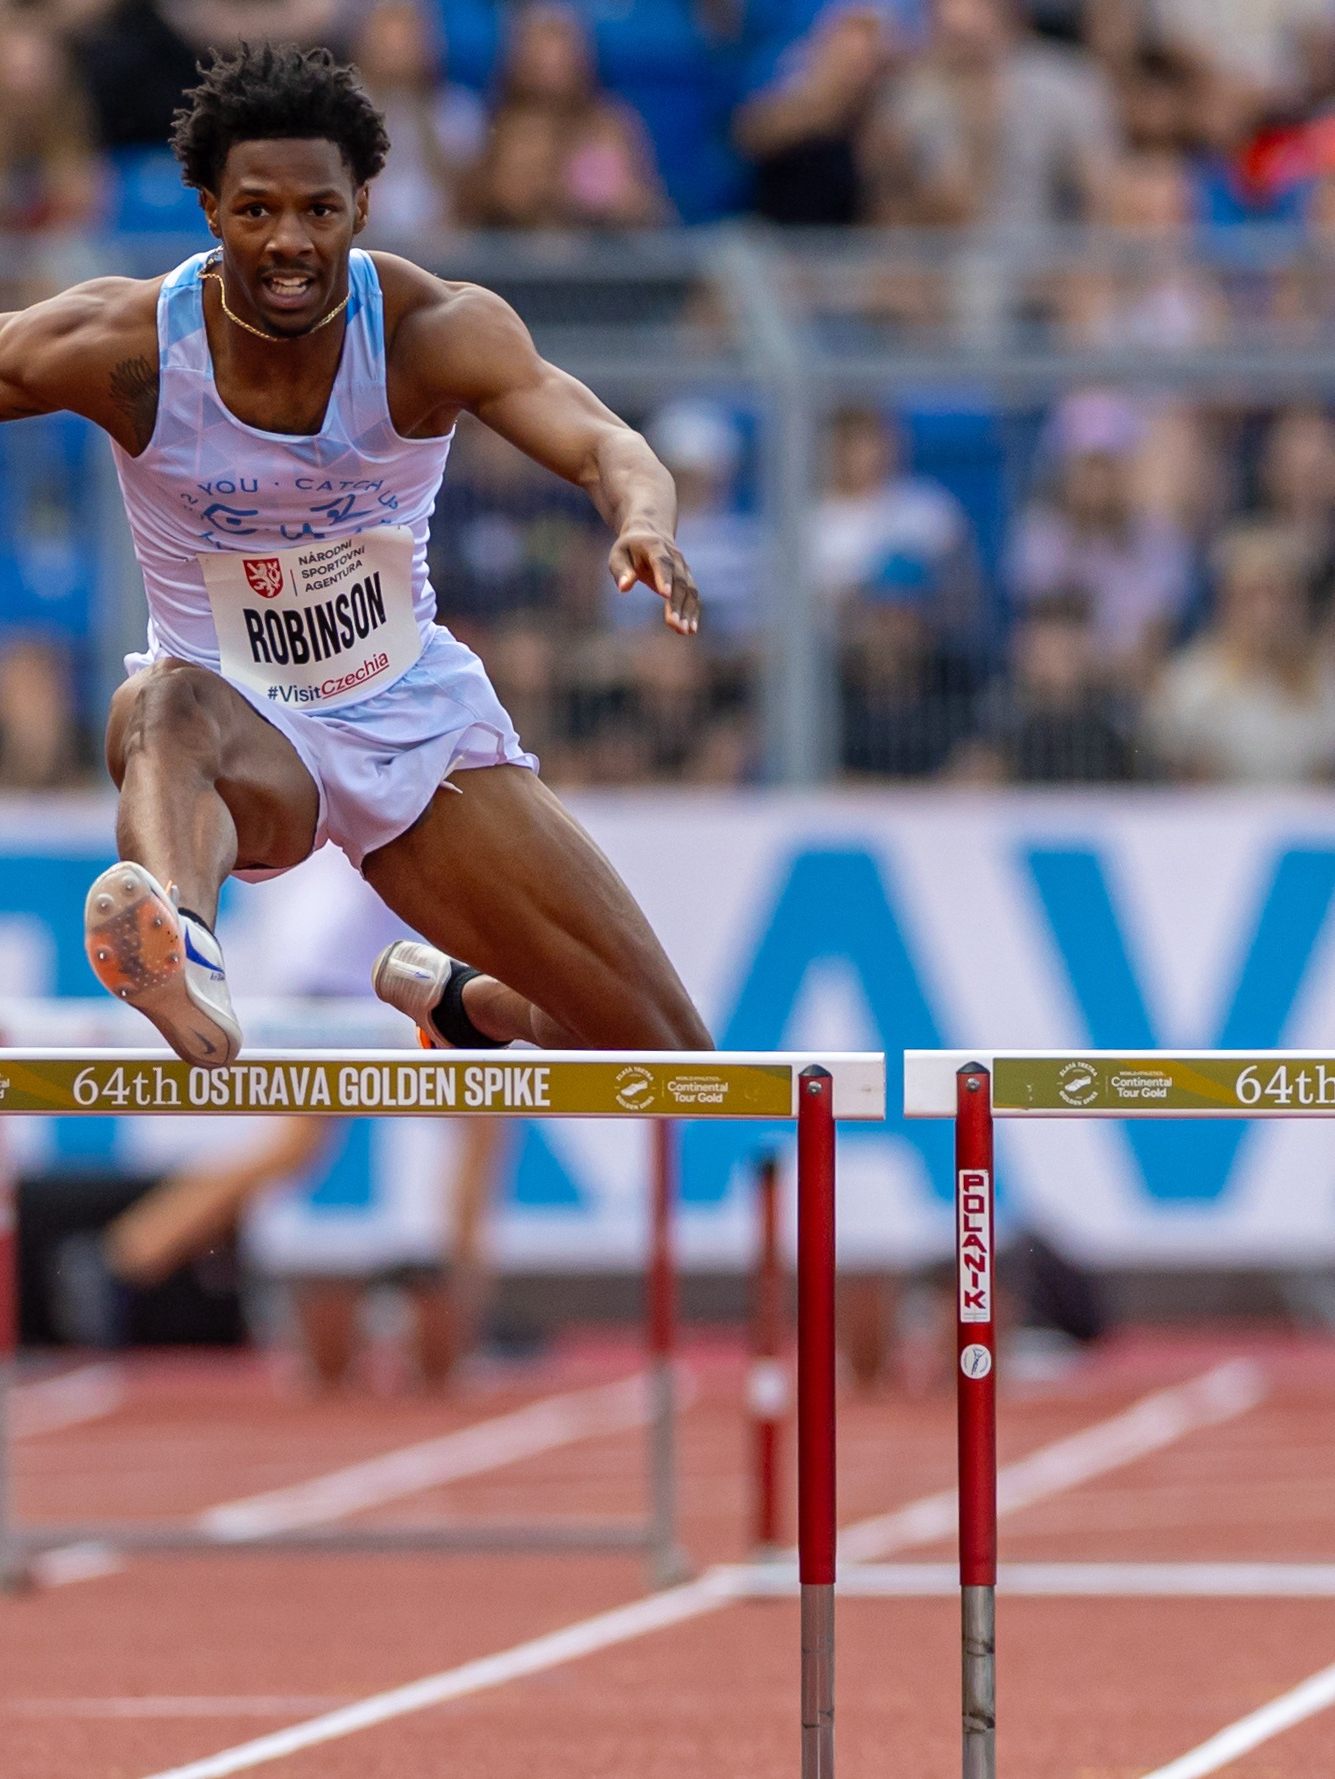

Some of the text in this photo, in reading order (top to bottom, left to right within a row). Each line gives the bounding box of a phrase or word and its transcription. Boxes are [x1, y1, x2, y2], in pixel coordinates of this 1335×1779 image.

[198, 478, 258, 497] YOU
[295, 478, 383, 492] CATCH
[299, 539, 352, 566] NÁRODNÍ
[301, 545, 365, 579] SPORTOVNÍ
[305, 560, 363, 593] AGENTURA
[243, 571, 387, 665] ROBINSON
[268, 652, 389, 702] #VisitCzechia
[73, 1067, 550, 1106] 64th OSTRAVA GOLDEN SPIKE
[668, 1080, 728, 1092] Continental
[674, 1090, 724, 1102] Tour Gold
[1111, 1076, 1172, 1087] Continental
[1117, 1086, 1167, 1098] Tour Gold
[1236, 1065, 1335, 1104] 64th
[962, 1174, 987, 1309] POLANIK
